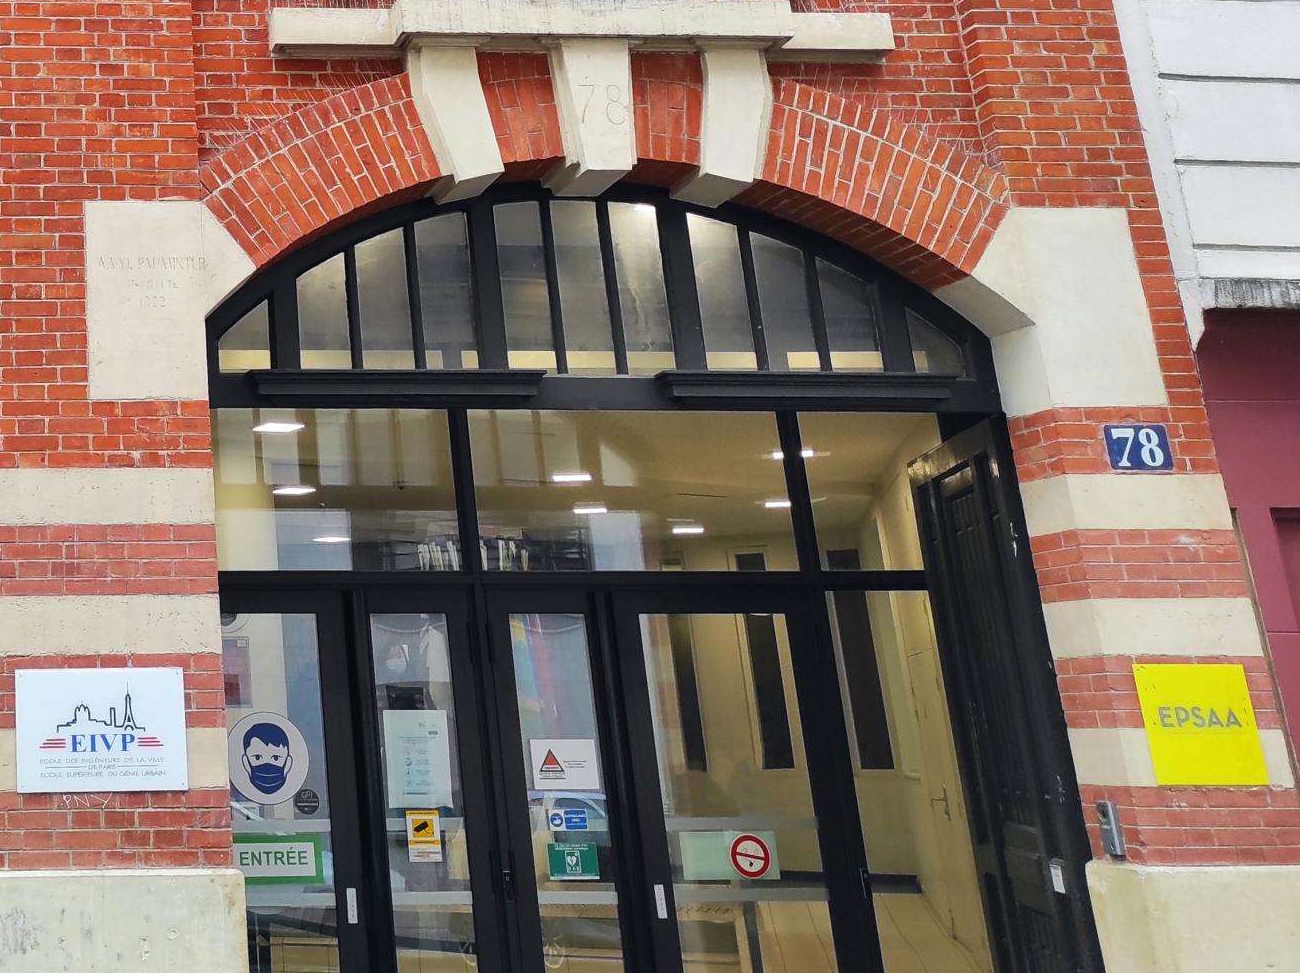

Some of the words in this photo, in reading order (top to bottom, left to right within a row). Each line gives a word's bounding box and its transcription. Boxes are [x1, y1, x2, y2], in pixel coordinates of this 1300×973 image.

[578, 84, 626, 125] 78
[1111, 428, 1164, 467] 78
[1158, 706, 1242, 728] EPSAA
[71, 734, 136, 753] EIVP
[239, 846, 308, 866] ENTRÉE
